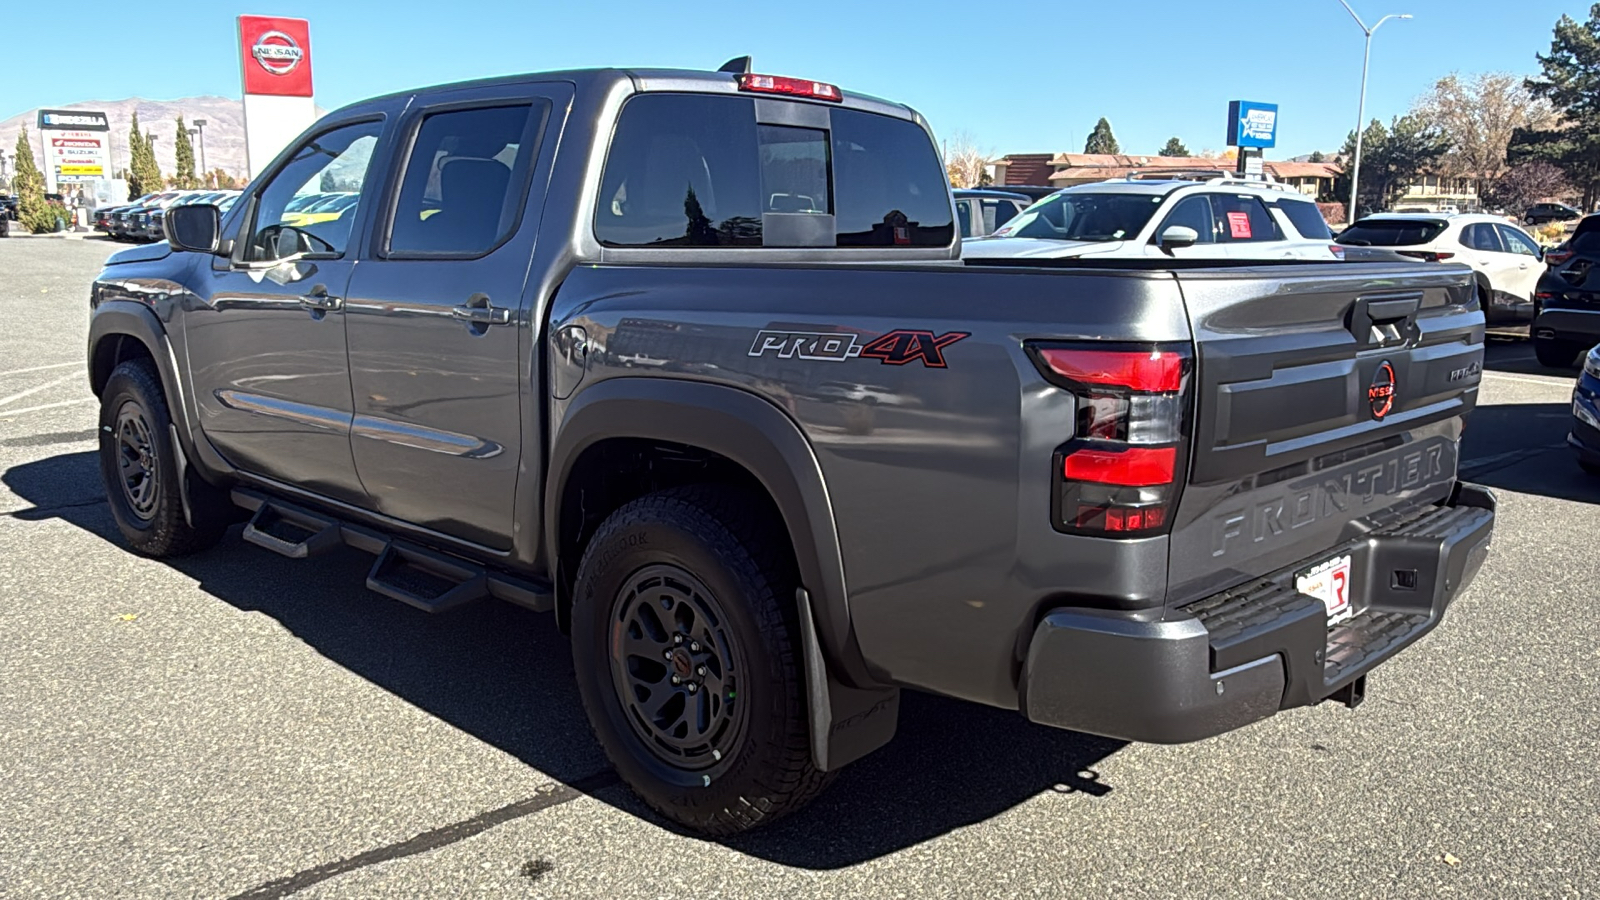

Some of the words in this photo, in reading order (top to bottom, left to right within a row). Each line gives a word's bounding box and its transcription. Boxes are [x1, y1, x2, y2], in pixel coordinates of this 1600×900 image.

[257, 47, 299, 57] NISSAN
[63, 140, 99, 148] HONDA
[1212, 443, 1443, 557] FRONTIER
